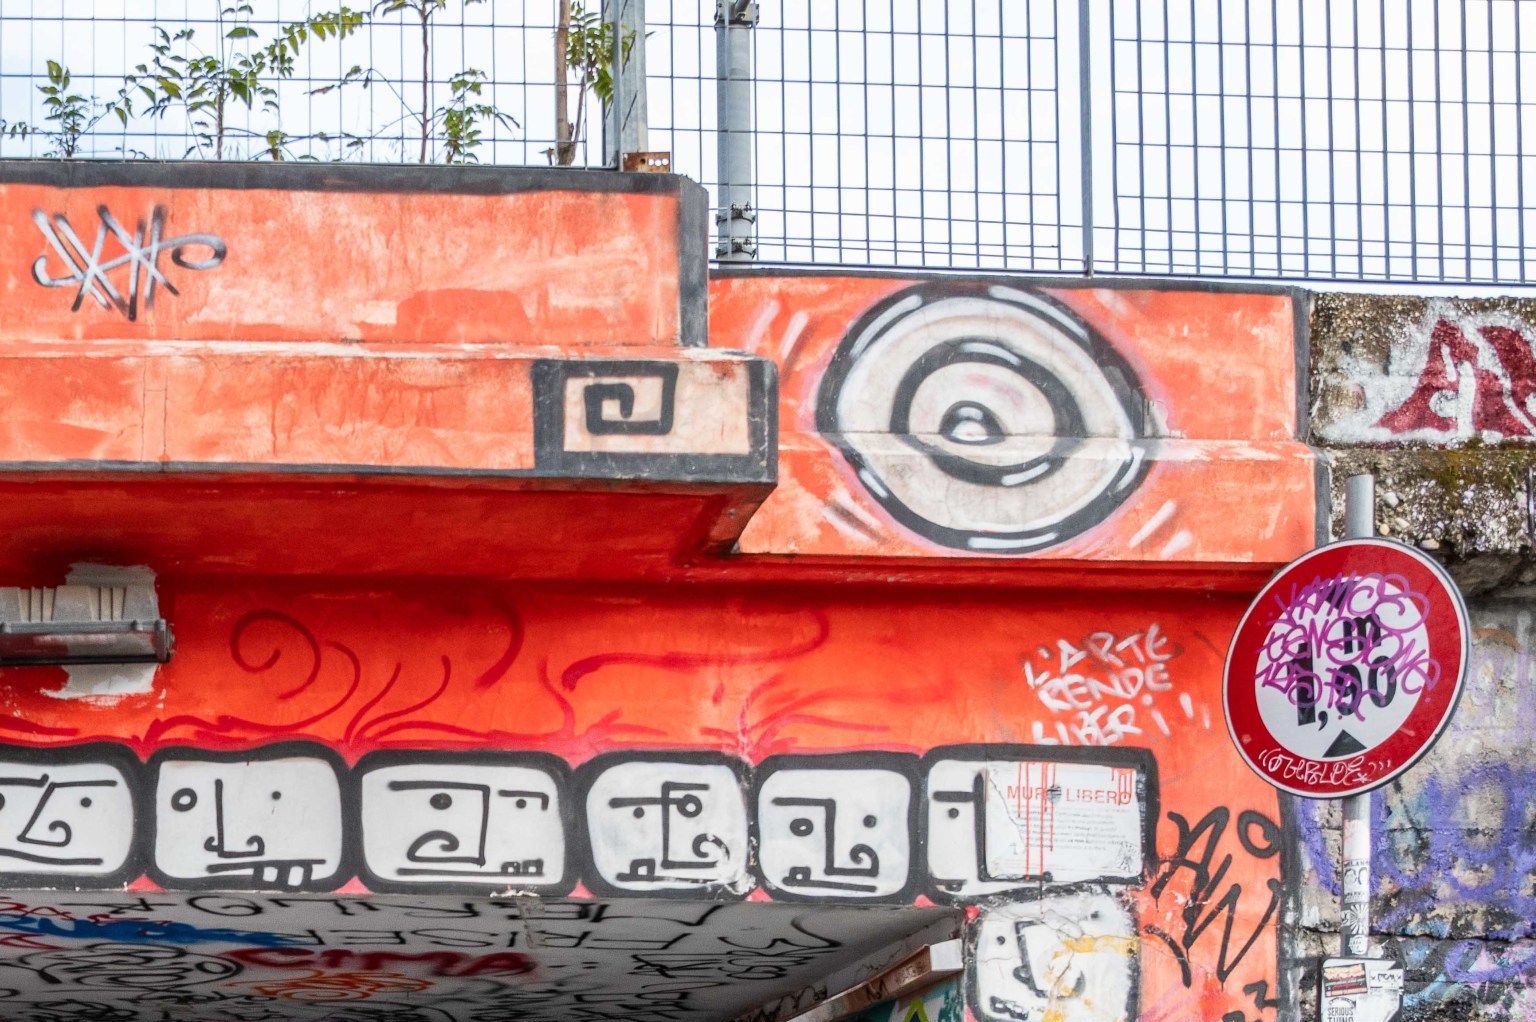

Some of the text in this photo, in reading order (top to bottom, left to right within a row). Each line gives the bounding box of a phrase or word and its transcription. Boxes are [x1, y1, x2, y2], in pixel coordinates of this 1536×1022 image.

[1037, 662, 1173, 713] RENDE
[1007, 785, 1131, 806] MUR LIBERO
[224, 947, 540, 977] CIMA
[1327, 1006, 1354, 1016] SERIOUS
